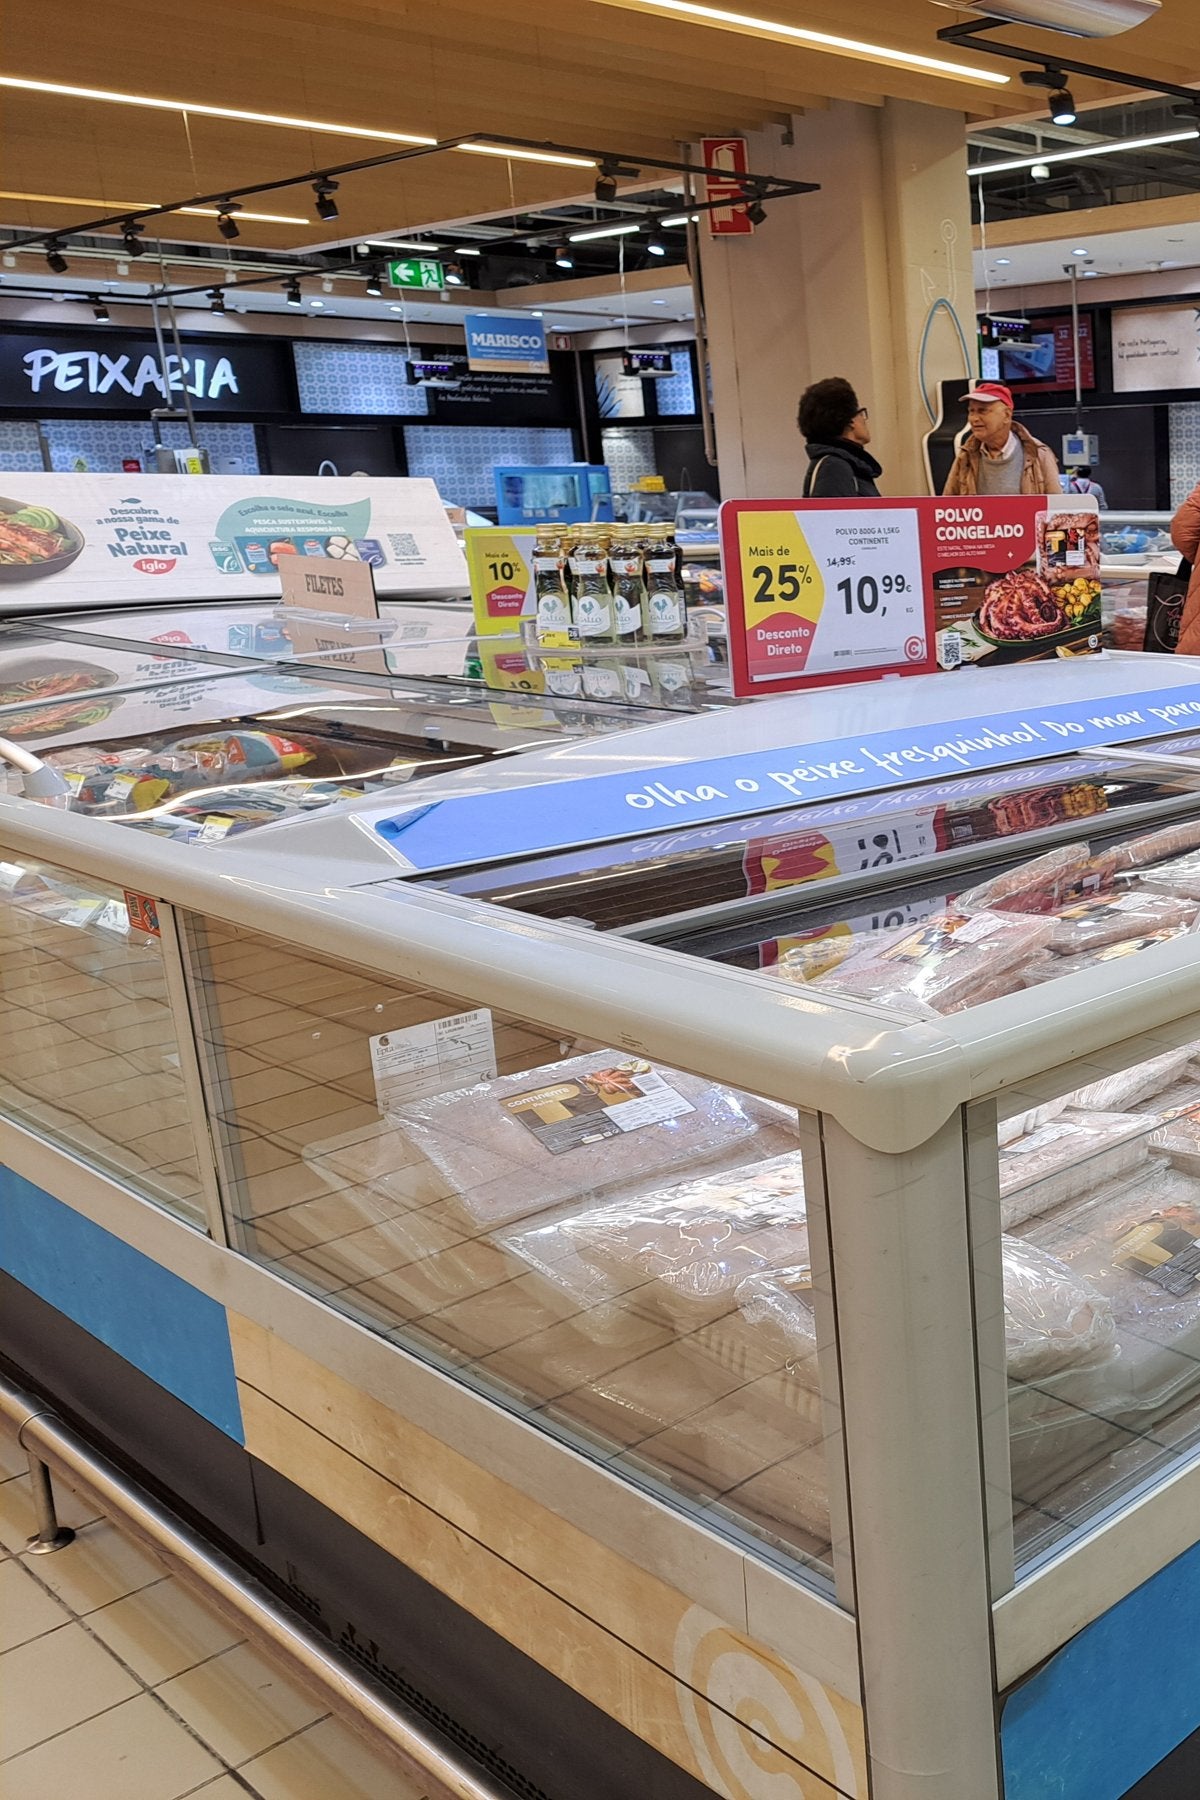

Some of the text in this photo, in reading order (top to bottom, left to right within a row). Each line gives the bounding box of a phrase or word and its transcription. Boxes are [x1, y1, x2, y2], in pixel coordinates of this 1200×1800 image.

[471, 333, 541, 348] MARISCO
[23, 349, 239, 398] PEIXARIA
[109, 507, 159, 515] Descubra
[935, 508, 983, 523] POLVO
[104, 516, 134, 524] nossa
[136, 516, 165, 524] gama
[166, 517, 180, 525] de
[114, 526, 172, 542] Peixe
[836, 528, 857, 536] POLVO
[936, 524, 1024, 541] CONGELADO
[107, 542, 188, 558] Natural
[749, 546, 790, 557] Mais de
[141, 560, 167, 572] iglo
[304, 574, 344, 596] FILETES
[757, 628, 810, 641] Desconto
[767, 644, 802, 656] Direto
[625, 781, 728, 809] olha
[734, 778, 760, 794] o
[768, 759, 865, 796] peixe
[859, 721, 1047, 777] fresquinho!
[1040, 720, 1085, 737] Do
[1086, 711, 1147, 731] mar
